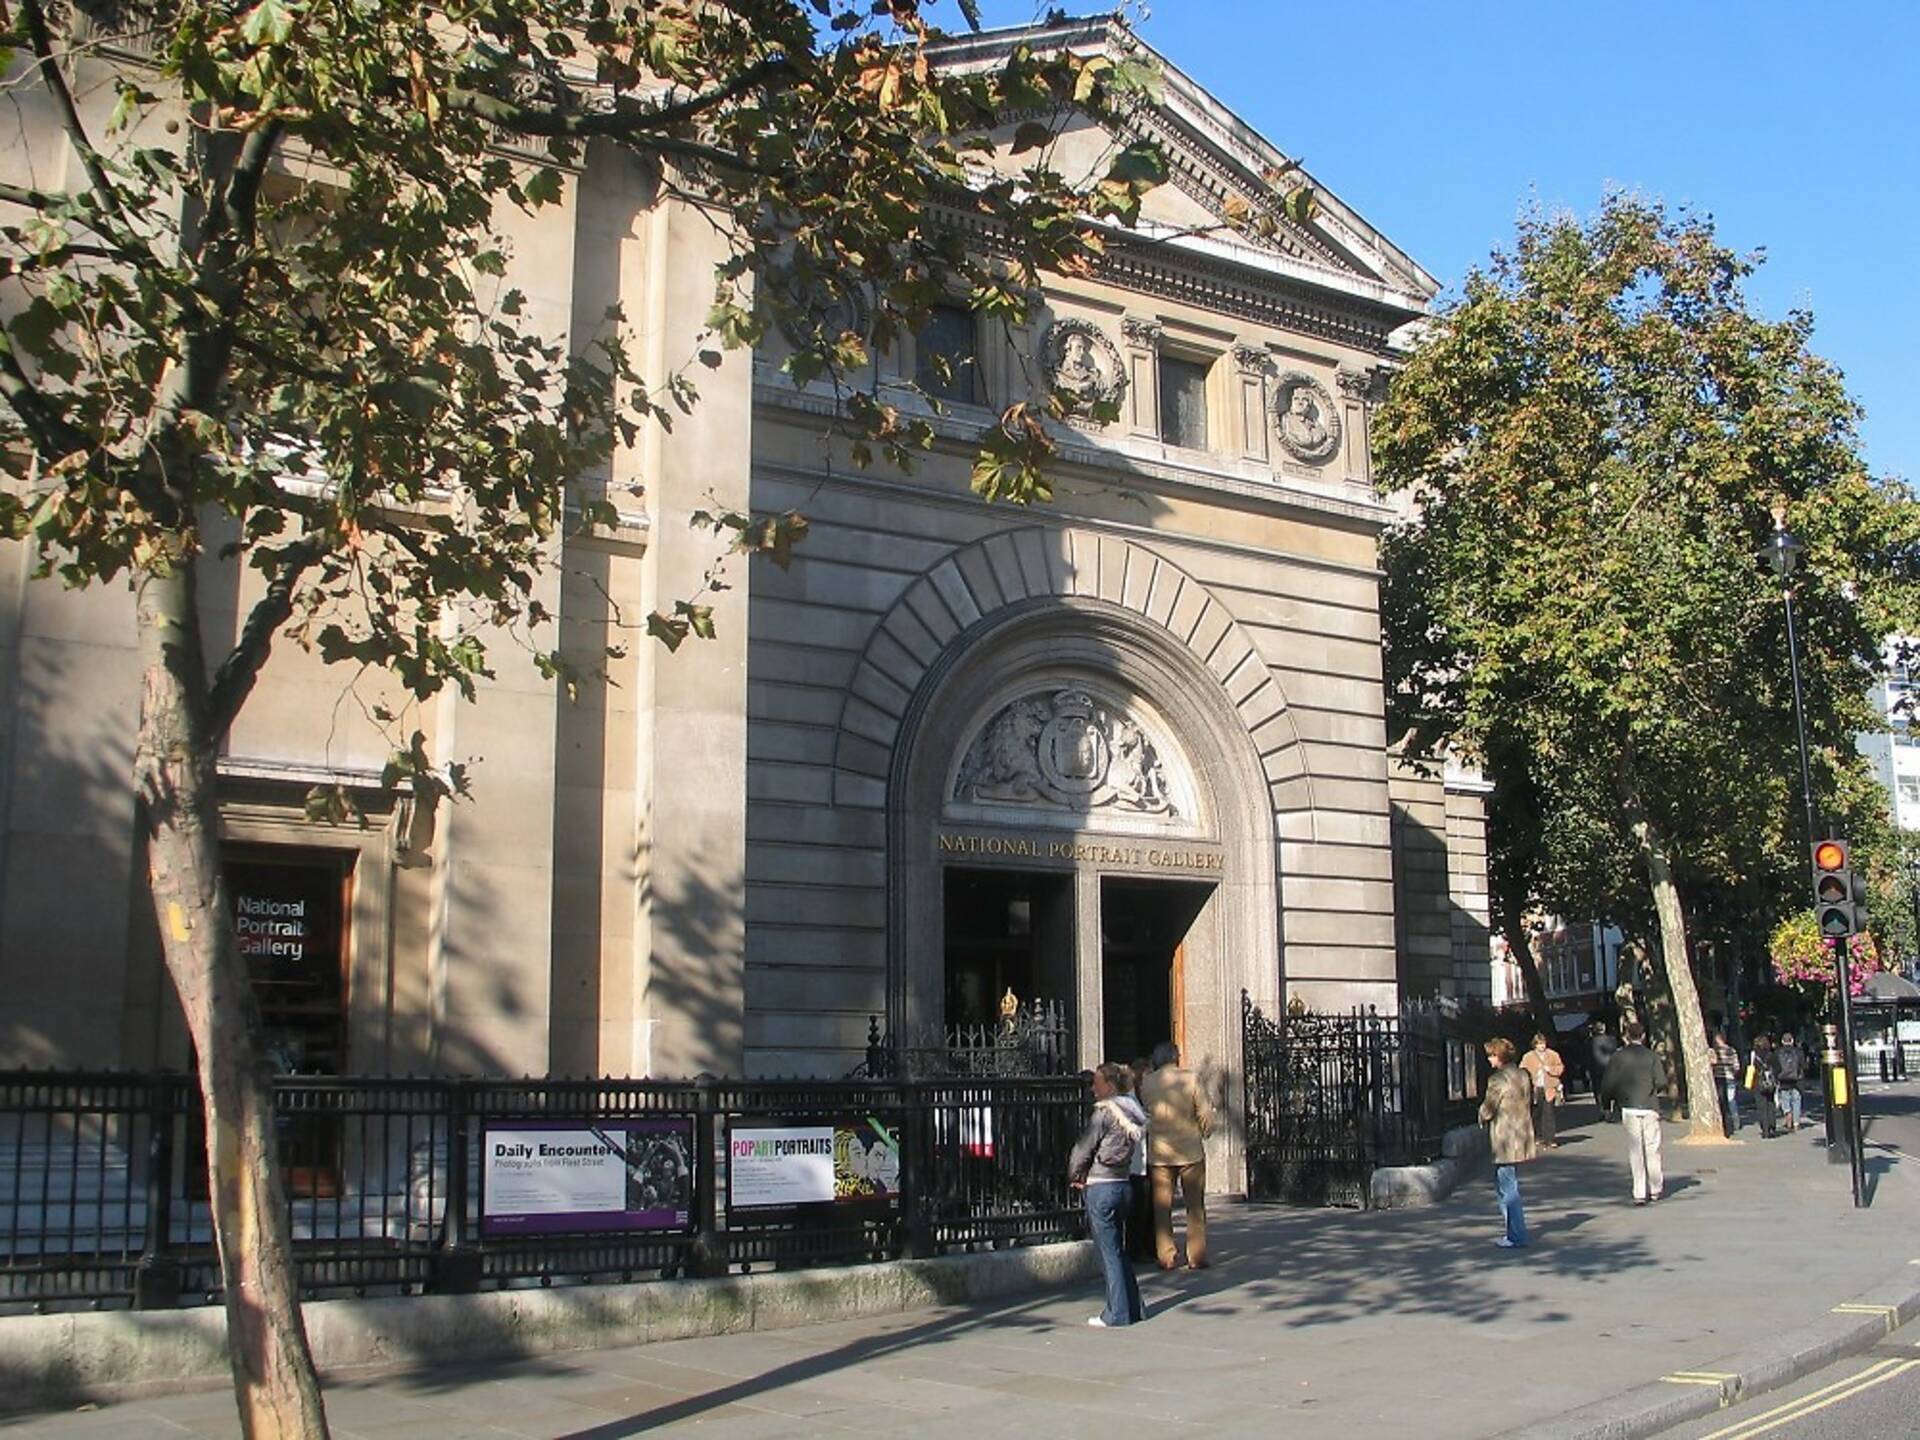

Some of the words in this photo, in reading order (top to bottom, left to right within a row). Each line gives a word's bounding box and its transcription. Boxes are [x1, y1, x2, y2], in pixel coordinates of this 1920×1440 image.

[938, 834, 1041, 857] NATIONAL
[1049, 842, 1141, 865] PORTRAIT
[1148, 849, 1225, 870] GALLERY
[238, 898, 304, 917] National
[237, 917, 304, 936] Portrait
[495, 1143, 533, 1159] Daily
[539, 1143, 618, 1157] Encounter
